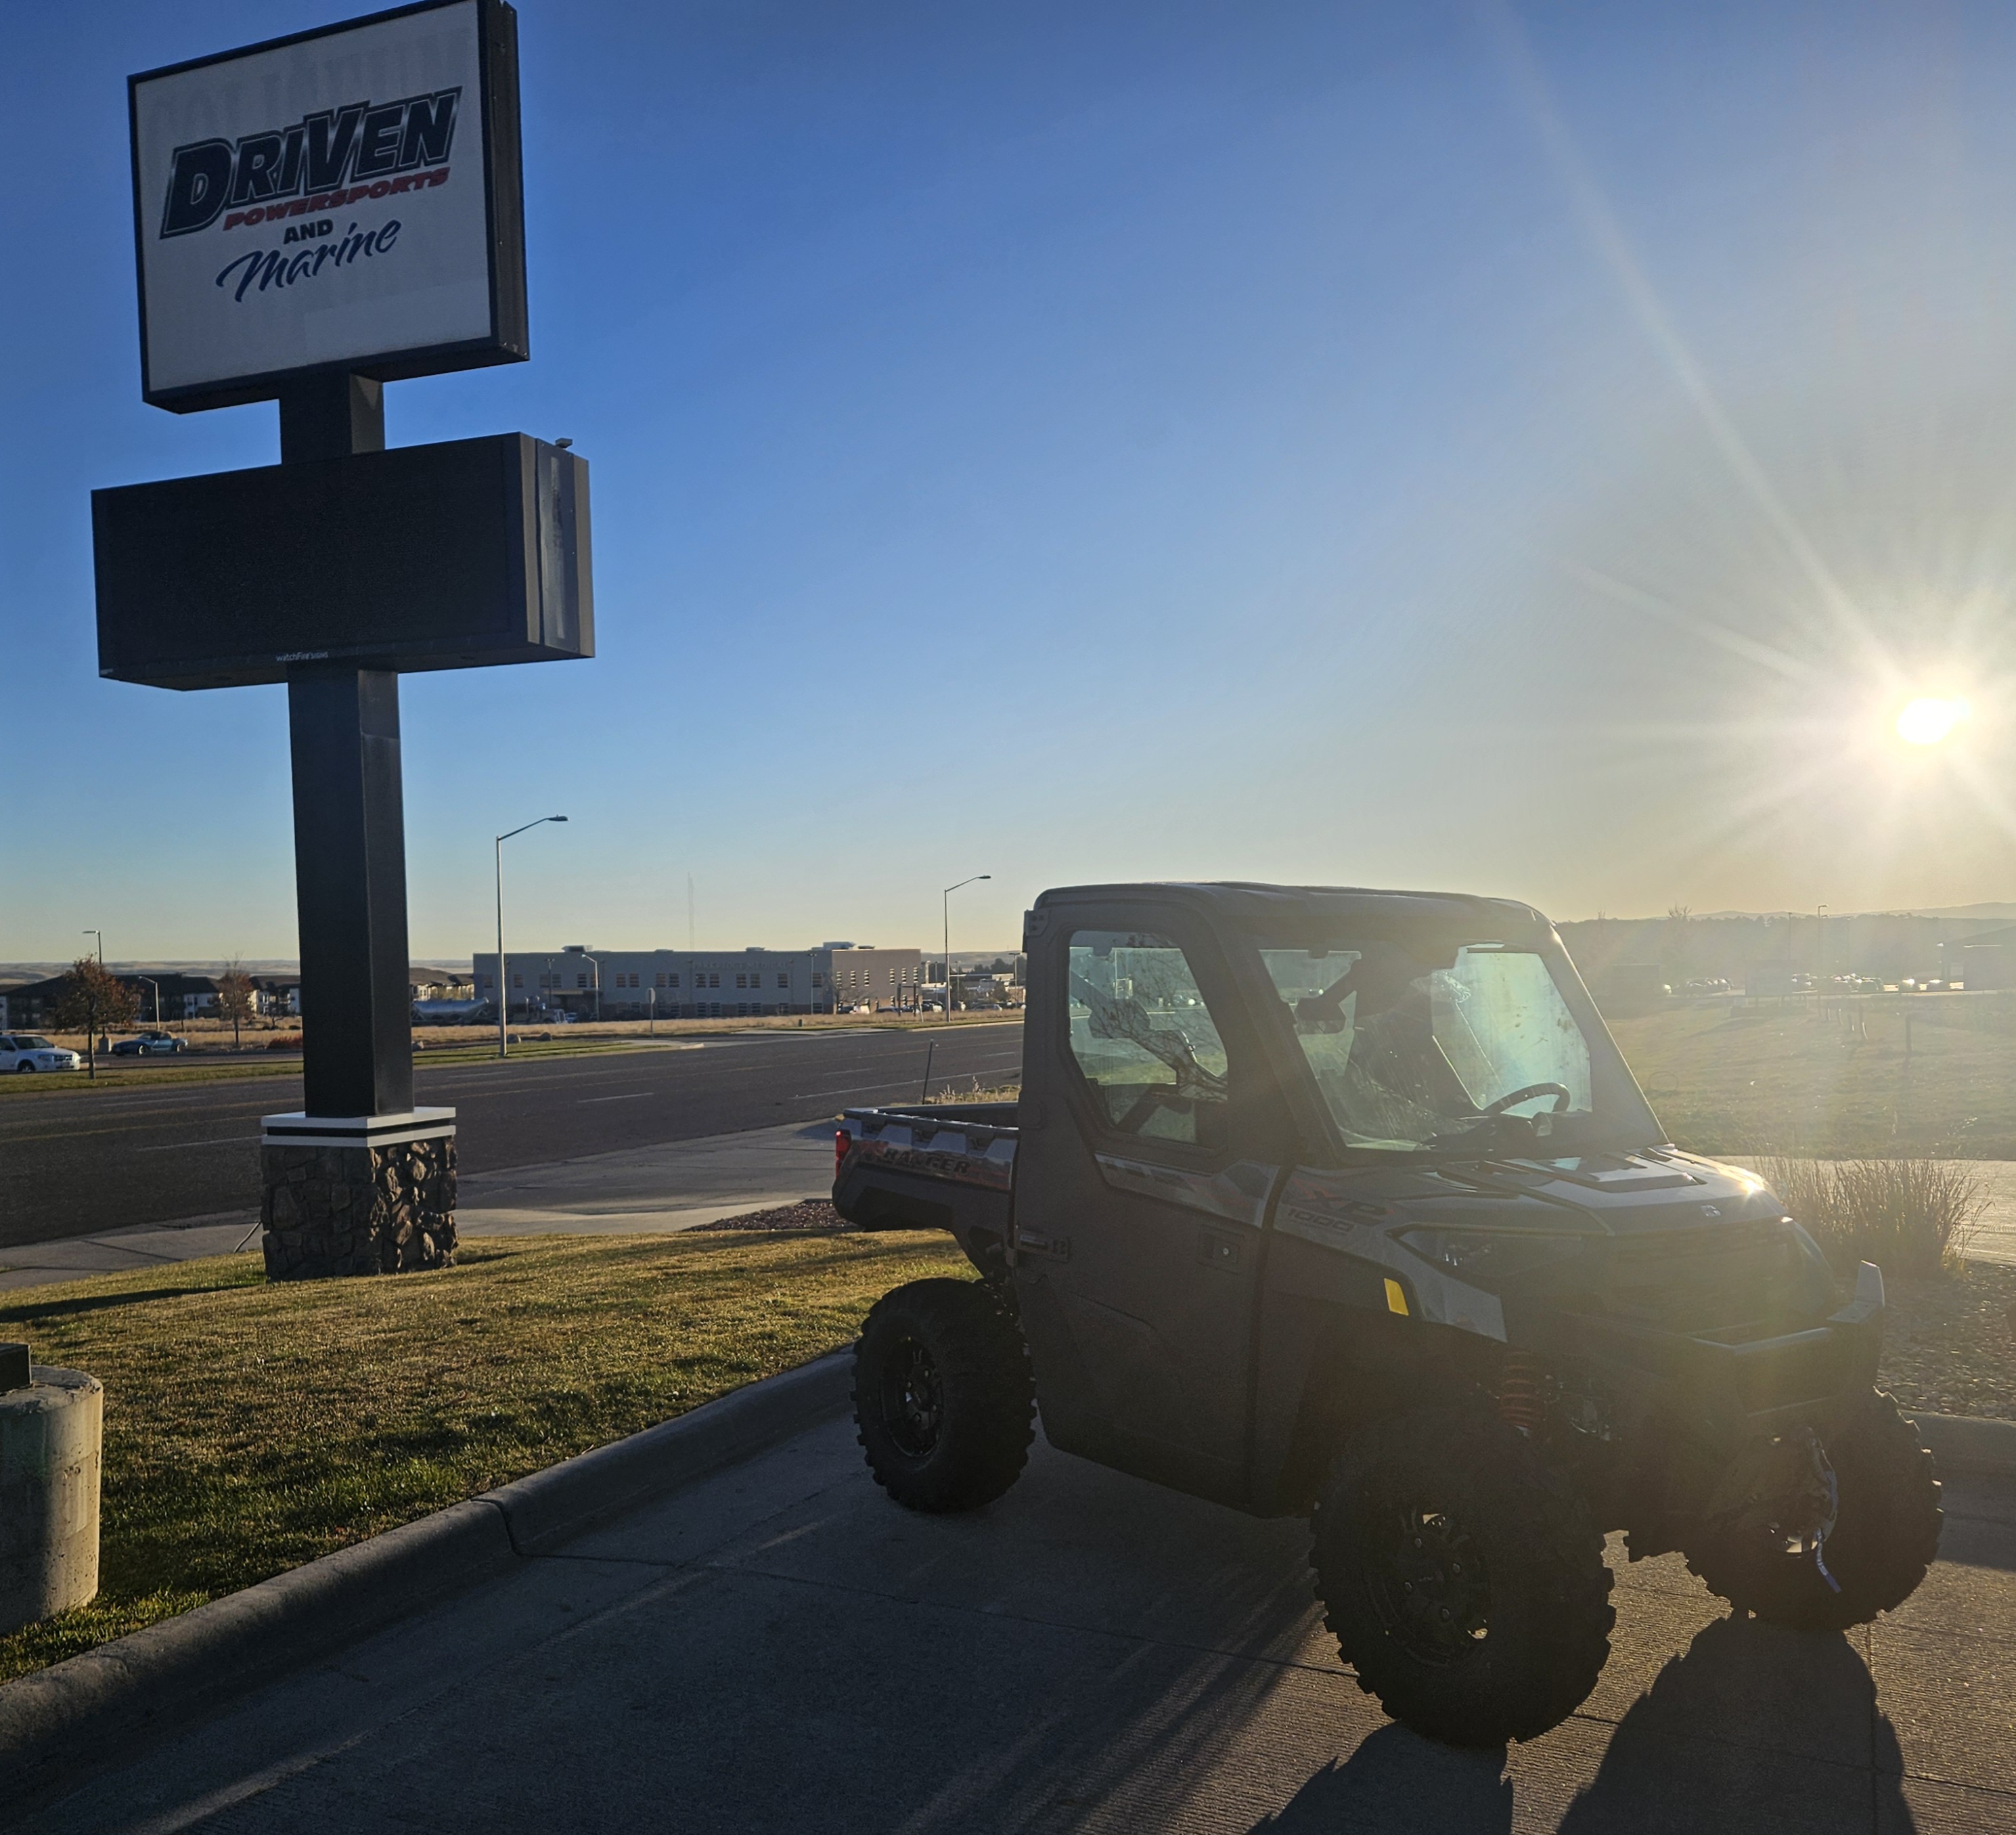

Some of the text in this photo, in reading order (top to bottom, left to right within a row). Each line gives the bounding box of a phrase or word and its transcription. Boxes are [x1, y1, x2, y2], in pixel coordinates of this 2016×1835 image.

[158, 86, 463, 240] DRIVEN
[222, 167, 451, 231] POWERSPORTS
[283, 218, 334, 244] AND
[215, 219, 402, 303] Marine
[884, 1148, 970, 1174] RANGER
[1287, 1208, 1355, 1232] 1000
